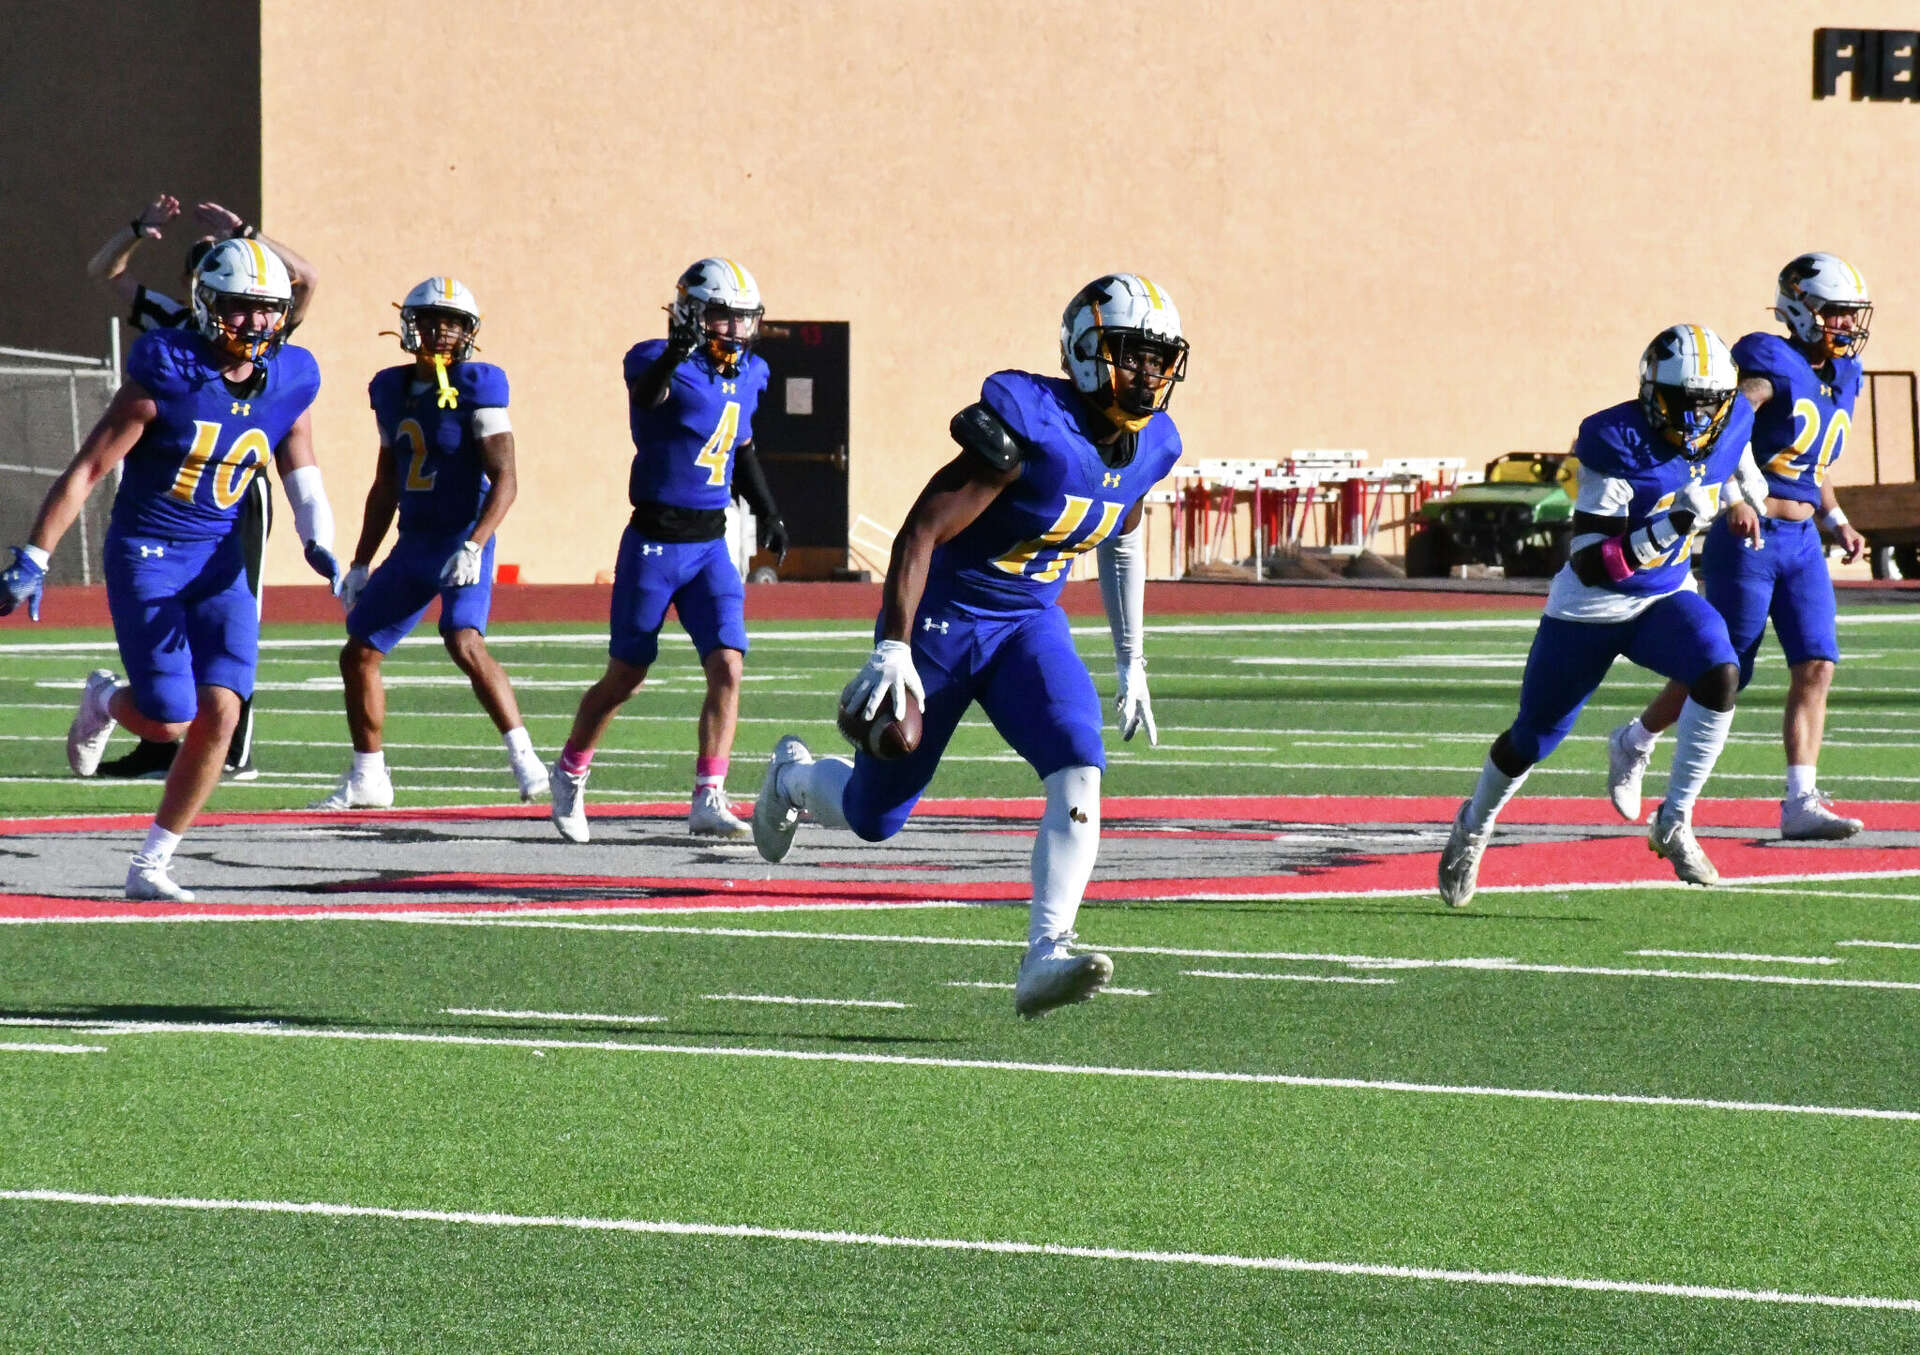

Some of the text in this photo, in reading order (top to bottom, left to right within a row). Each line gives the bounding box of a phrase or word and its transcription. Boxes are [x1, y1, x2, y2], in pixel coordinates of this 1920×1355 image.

[170, 419, 271, 511] 10
[395, 417, 438, 492] 2
[695, 401, 741, 486] 4
[1766, 398, 1852, 488] 20
